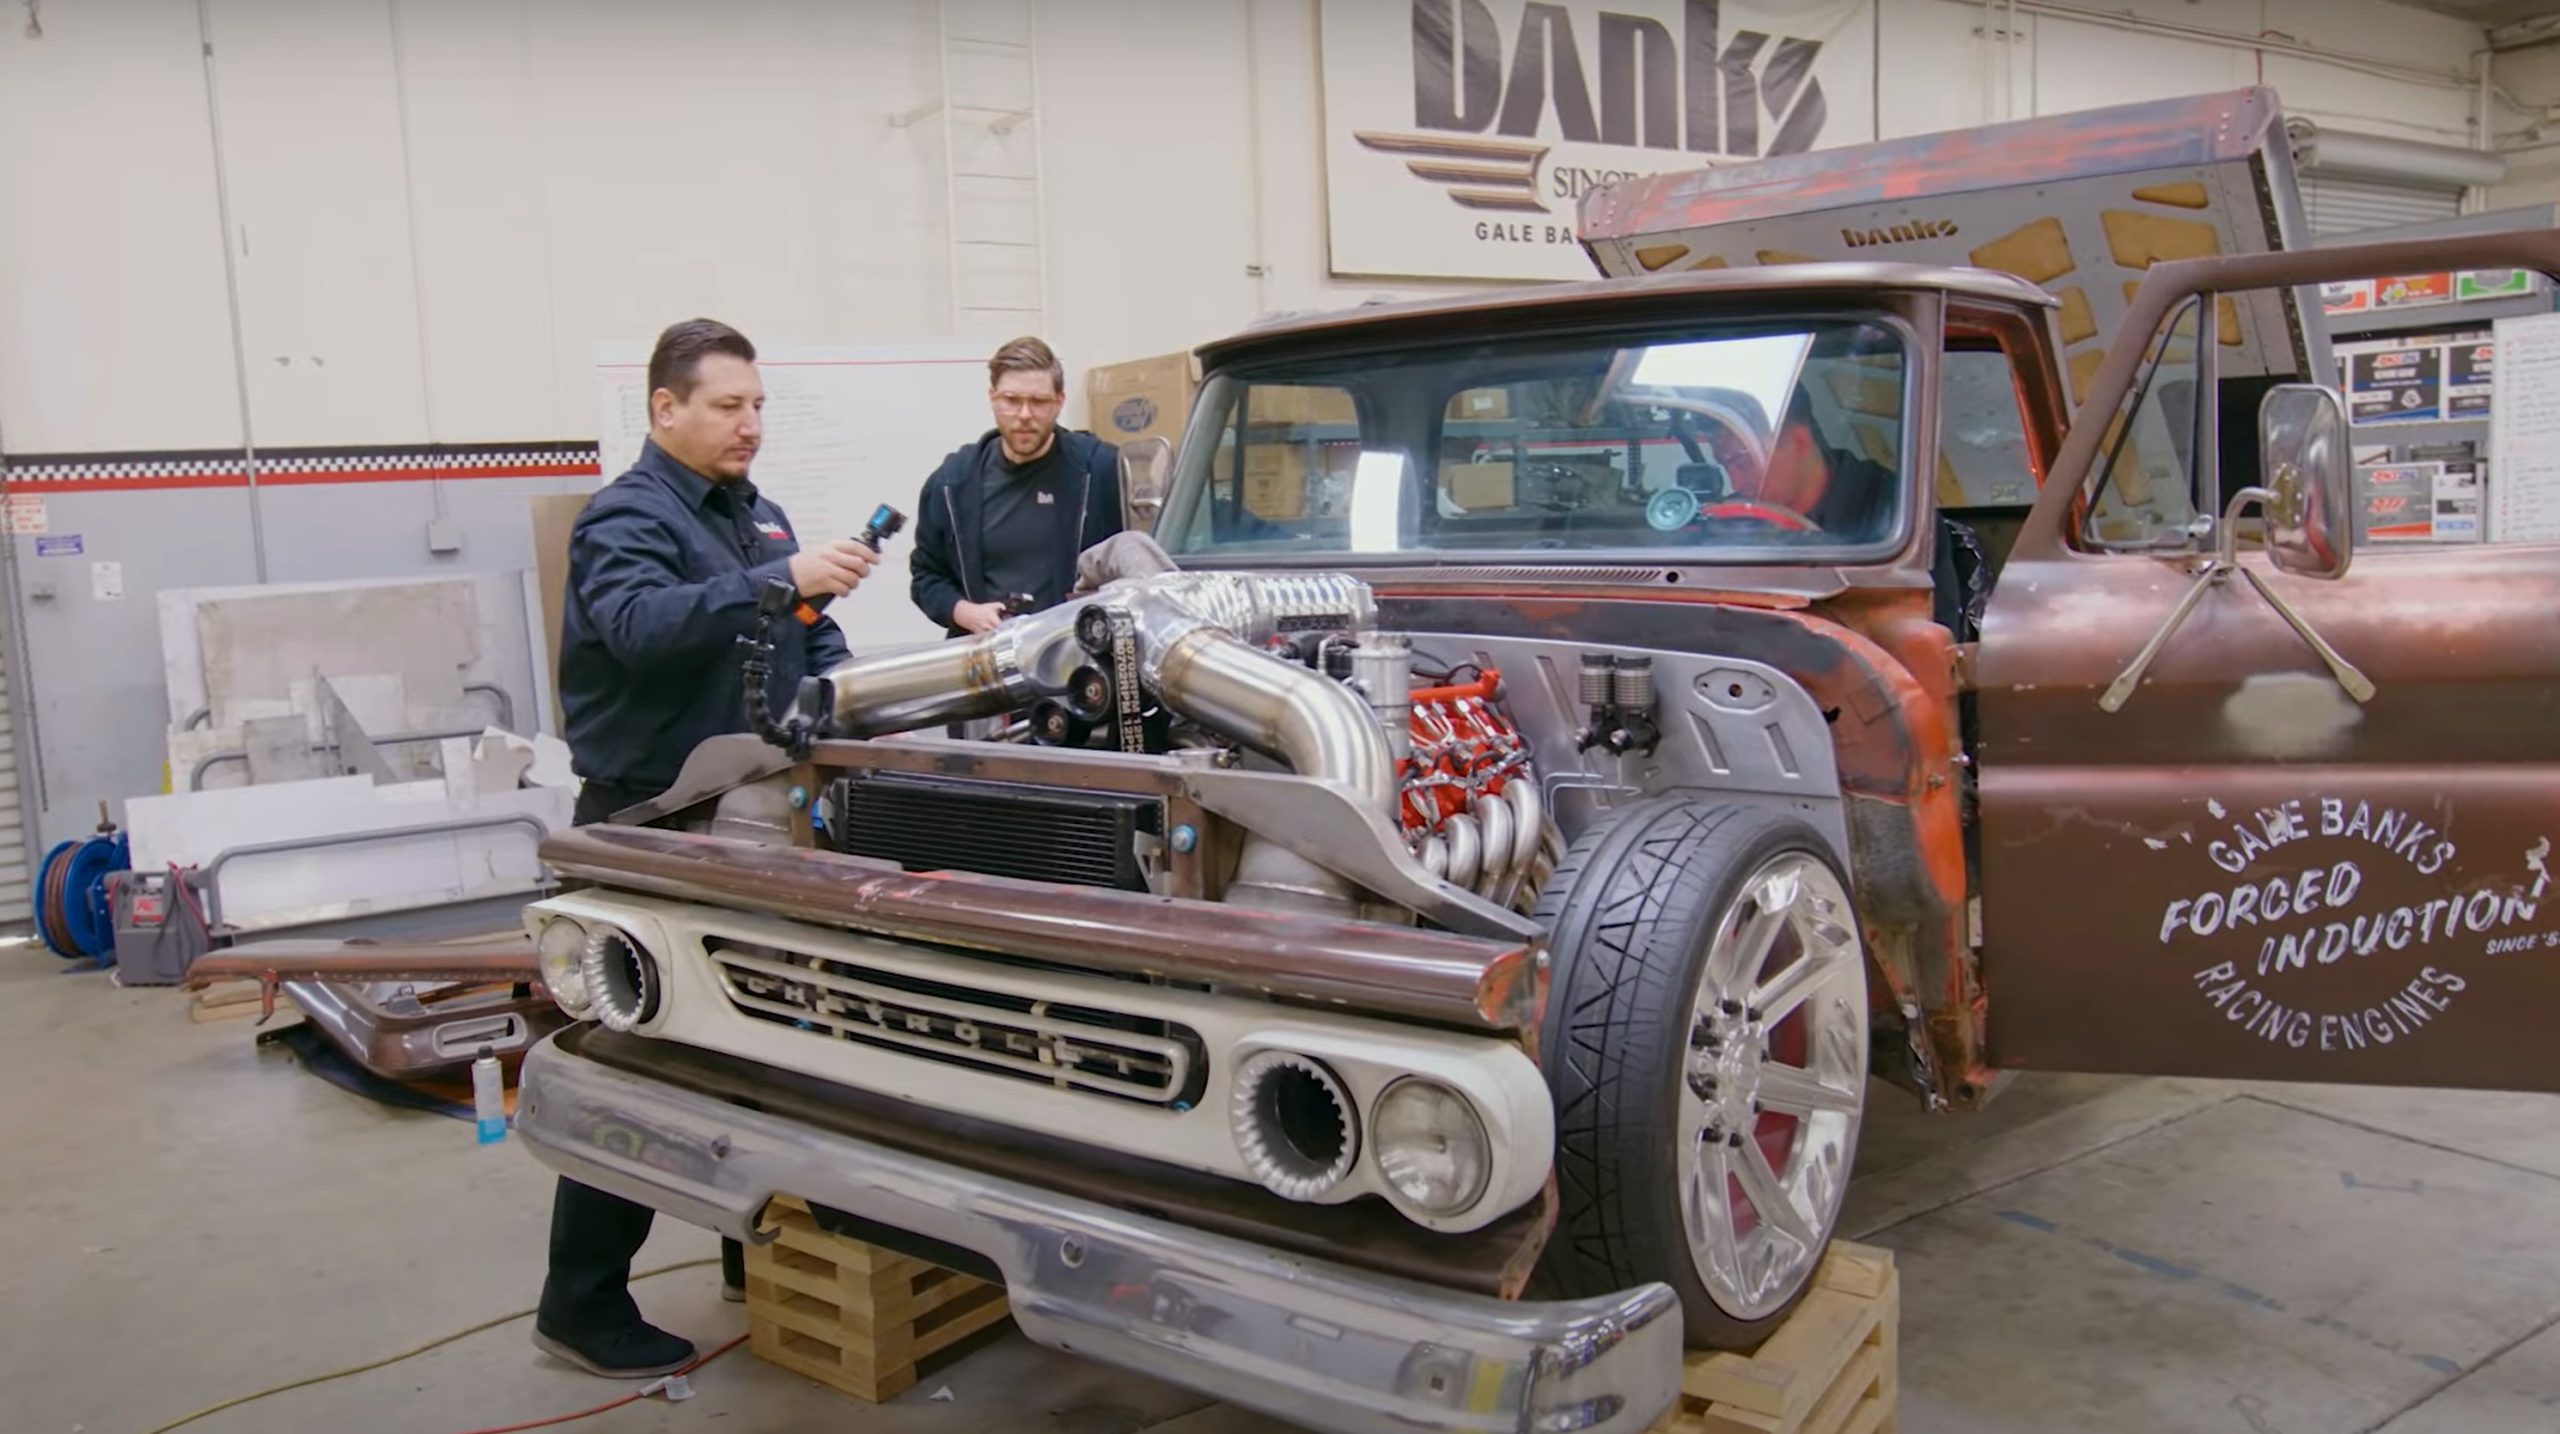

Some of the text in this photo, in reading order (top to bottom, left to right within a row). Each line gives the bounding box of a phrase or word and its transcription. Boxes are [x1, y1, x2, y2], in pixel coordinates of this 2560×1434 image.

[1475, 222, 1534, 243] GALE
[2208, 798, 2456, 875] GALE BANKS
[2159, 860, 2361, 944] FORCED
[2257, 872, 2549, 976] INDUCTION
[2486, 934, 2538, 955] SINCE
[2194, 960, 2467, 1051] RACING ENGINES
